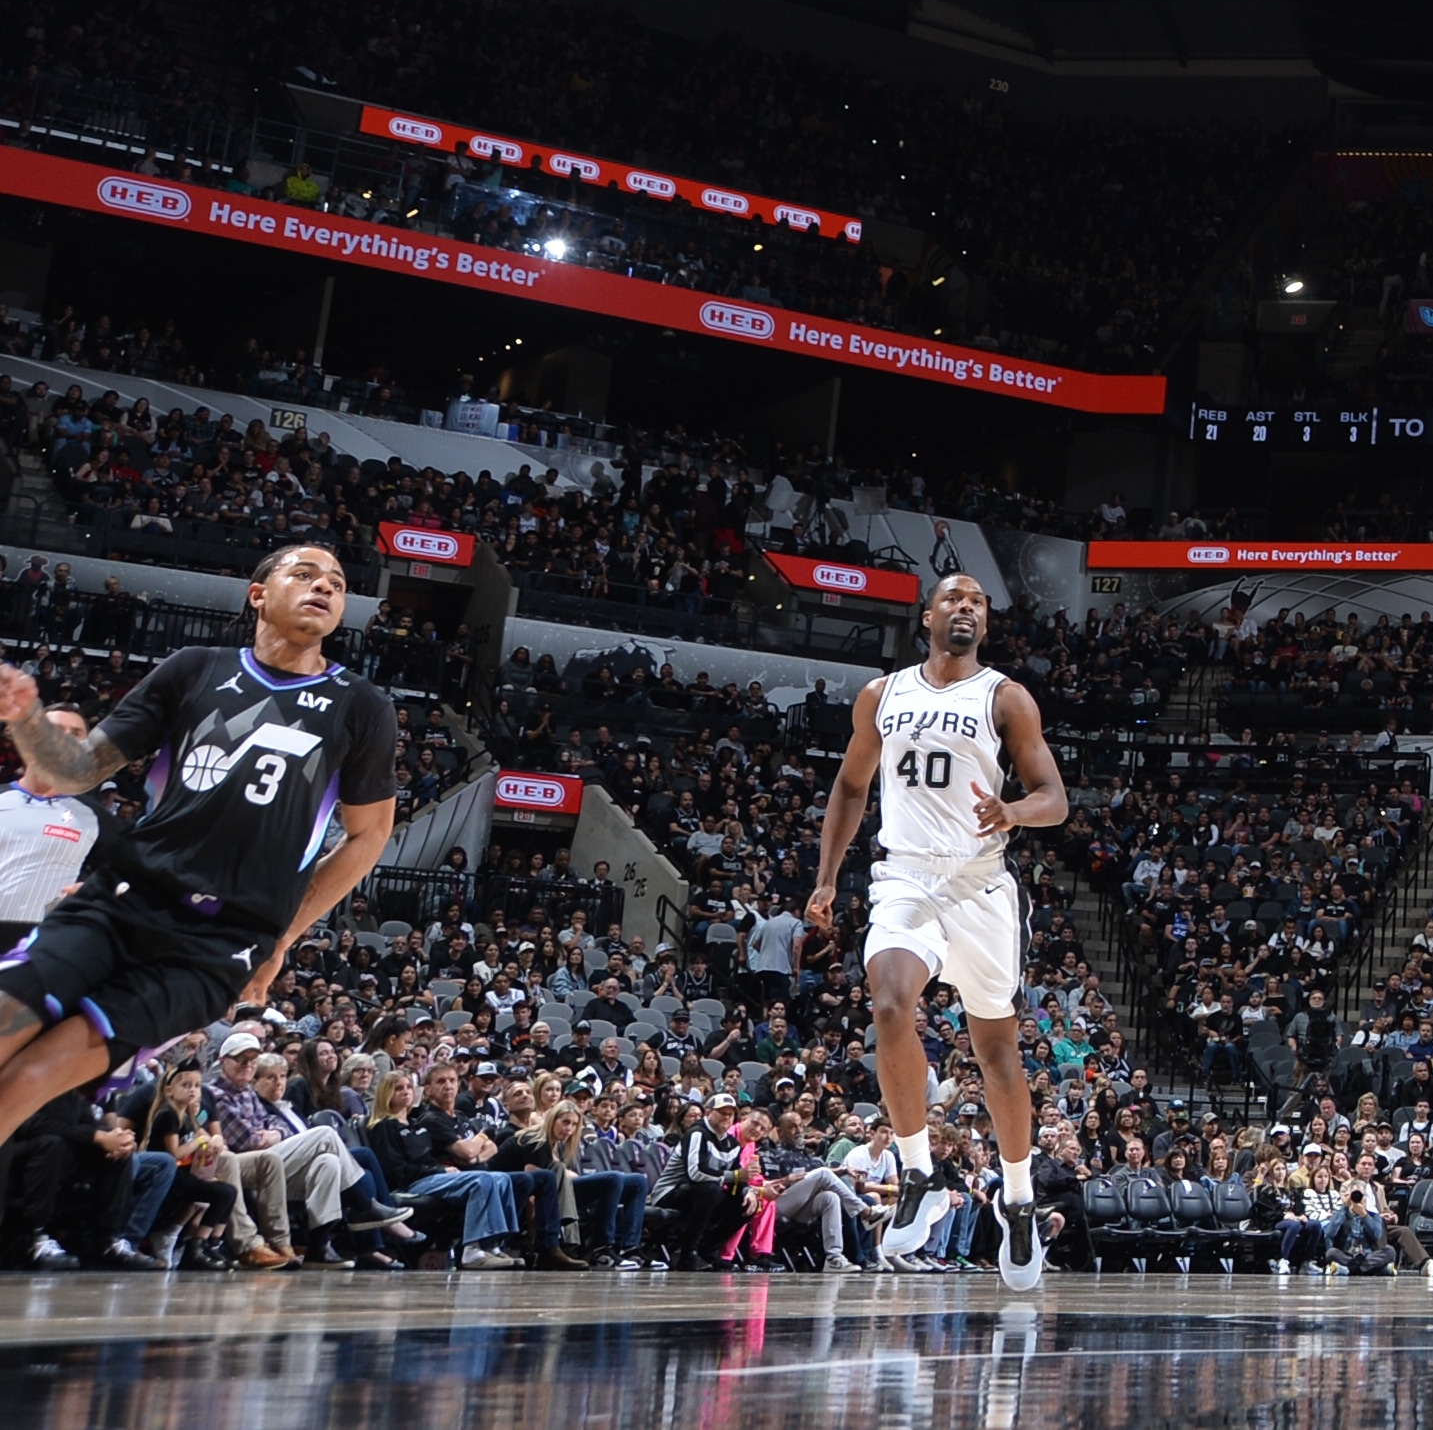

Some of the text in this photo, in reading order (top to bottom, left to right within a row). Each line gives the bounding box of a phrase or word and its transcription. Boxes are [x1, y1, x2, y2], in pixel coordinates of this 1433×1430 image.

[208, 200, 276, 234] Here
[283, 216, 449, 270] Everything's
[456, 252, 540, 287] Better
[790, 322, 843, 349] Here
[849, 335, 983, 380] Everything's
[989, 364, 1056, 393] Better
[1198, 409, 1368, 423] REB AST STL BLK
[1388, 418, 1425, 437] TO
[1205, 424, 1358, 443] 21 20 3 3
[1237, 549, 1397, 563] Here Everything's Better
[1093, 579, 1119, 592] 127
[882, 711, 979, 741] SPURS
[245, 753, 287, 806] 3
[896, 750, 952, 789] 40
